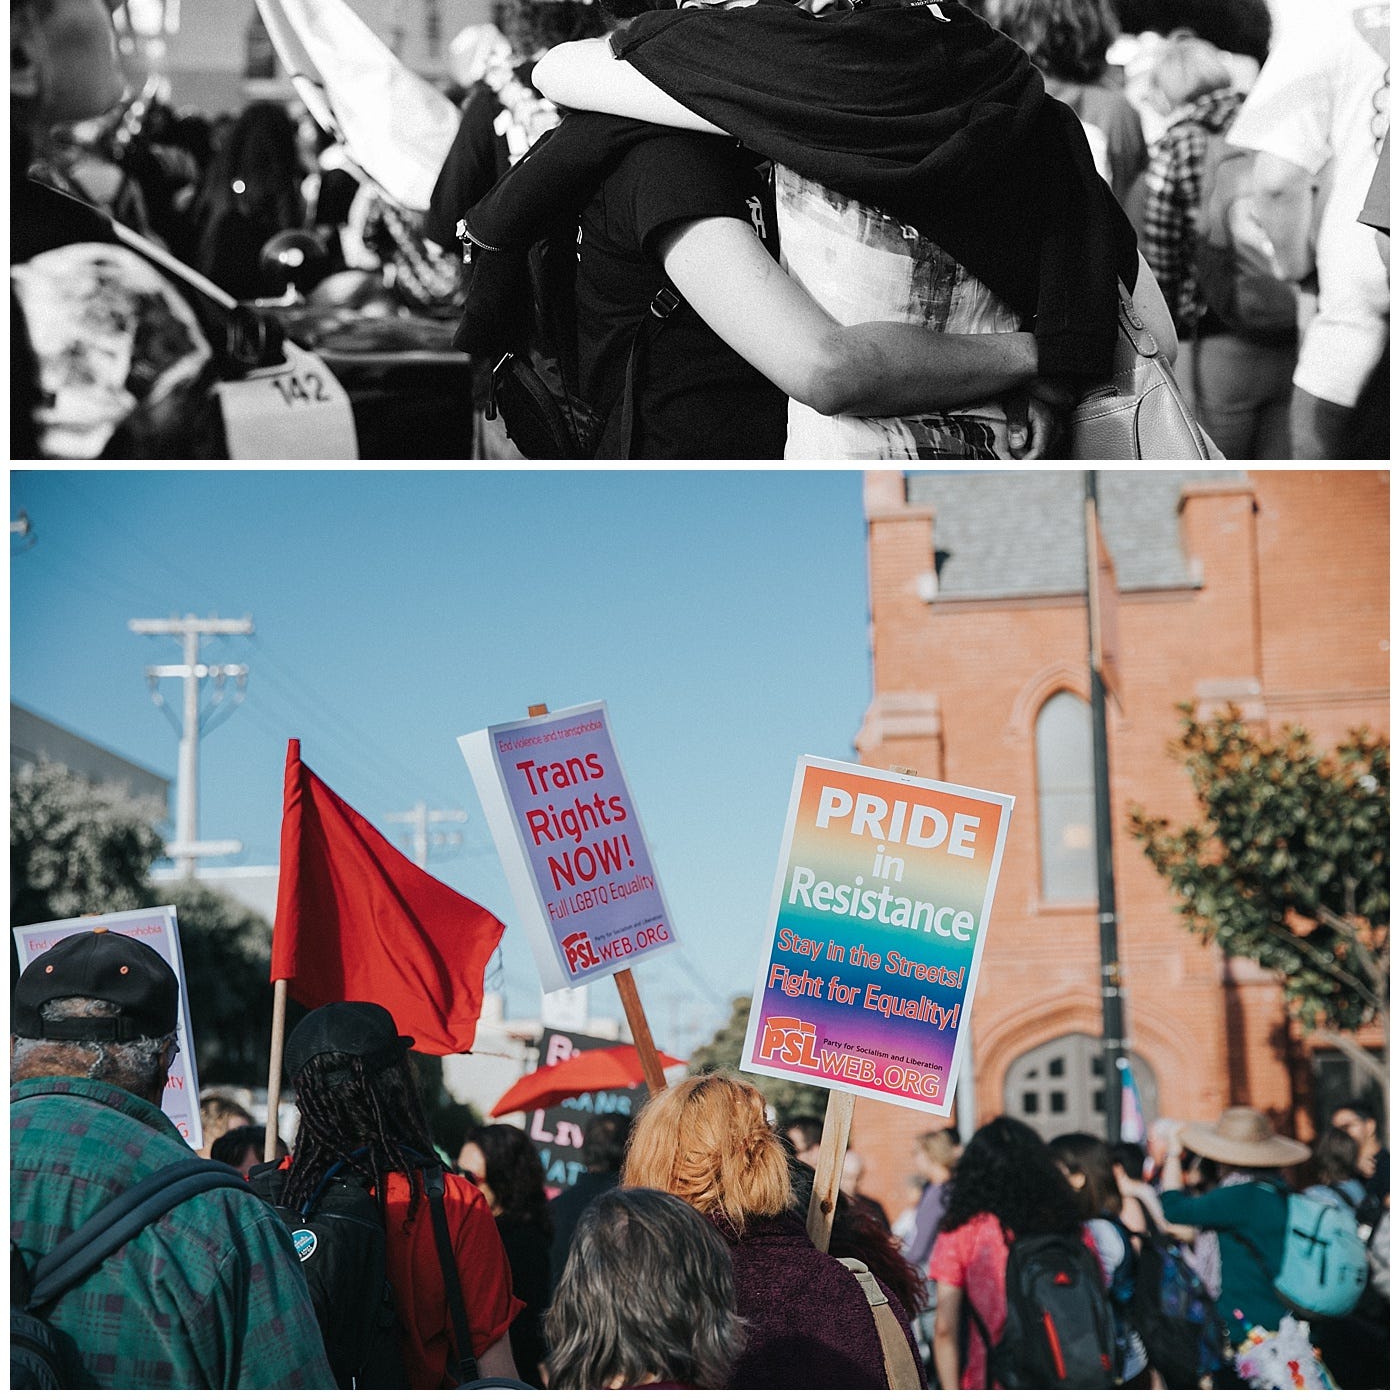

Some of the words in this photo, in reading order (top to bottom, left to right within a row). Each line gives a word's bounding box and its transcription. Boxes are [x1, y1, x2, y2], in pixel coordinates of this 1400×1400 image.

[273, 373, 330, 406] 142
[499, 740, 513, 752] End
[514, 736, 542, 749] violence
[543, 730, 557, 742] and
[557, 720, 602, 737] transphobia
[516, 752, 605, 796] Trans
[526, 792, 628, 846] Rights
[815, 786, 981, 859] PRIDE
[547, 834, 635, 891] NOW!
[872, 844, 905, 882] in
[547, 897, 569, 921] Full
[569, 886, 609, 914] LGBTQ
[609, 874, 655, 900] Equality
[788, 866, 975, 941] Resistance
[29, 940, 46, 951] End
[778, 928, 824, 961] Stay
[827, 940, 845, 963] in
[850, 944, 881, 970] the
[885, 951, 965, 989] Streets!
[768, 963, 824, 998] Fight
[828, 976, 861, 1005] for
[864, 984, 960, 1031] Equality!
[823, 1038, 842, 1049] Party
[844, 1042, 854, 1051] for
[856, 1046, 889, 1059] Socialism
[891, 1054, 904, 1063] and
[906, 1057, 943, 1071] Liberation
